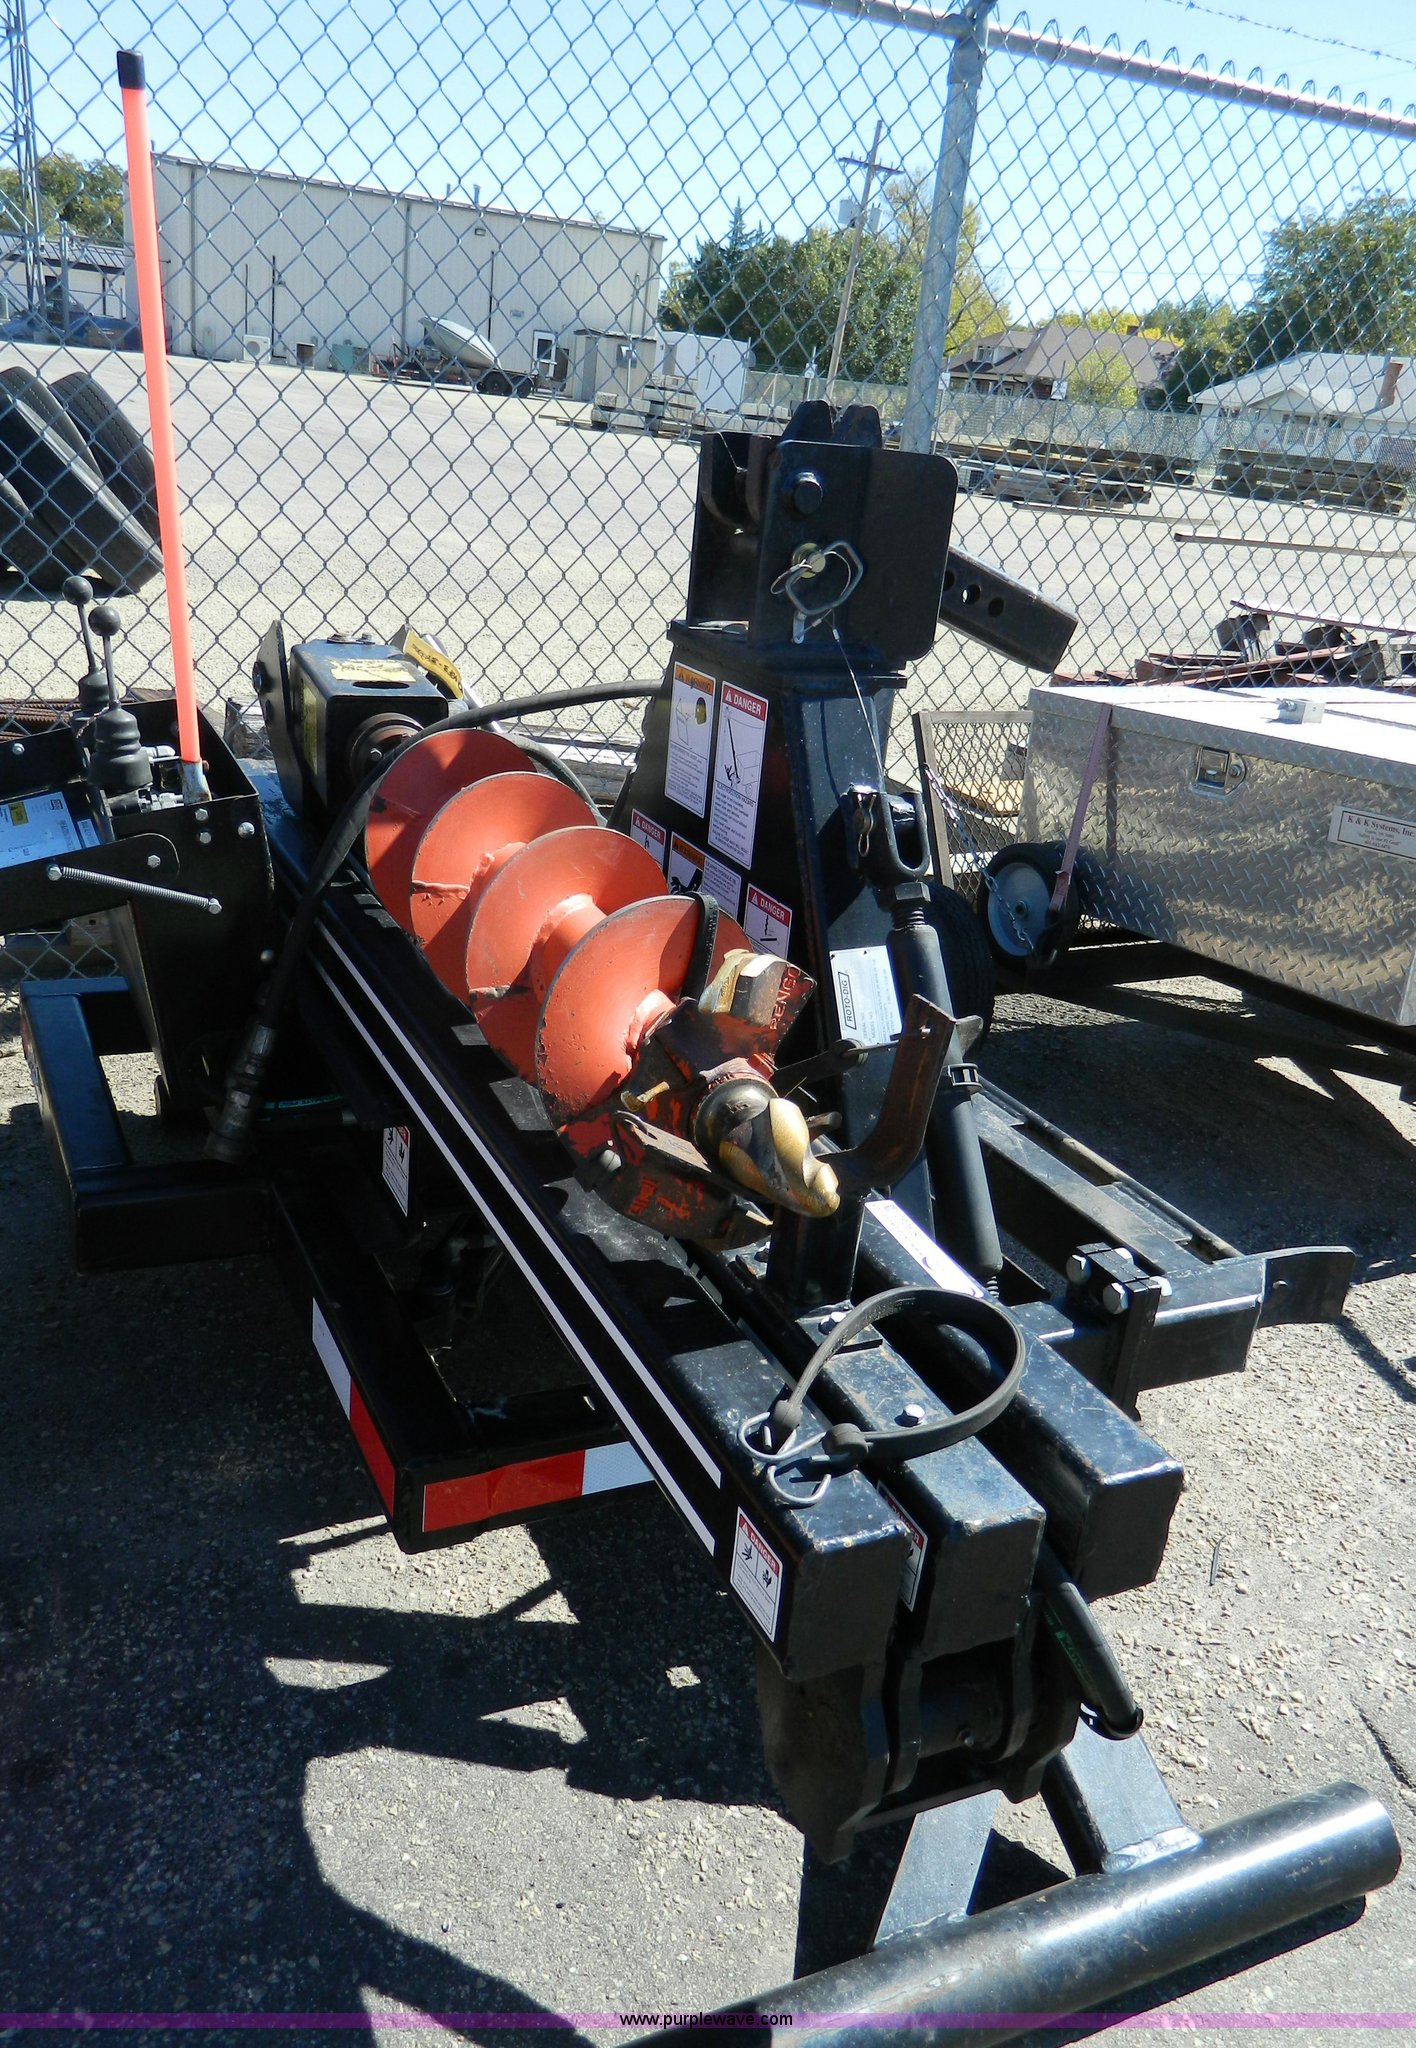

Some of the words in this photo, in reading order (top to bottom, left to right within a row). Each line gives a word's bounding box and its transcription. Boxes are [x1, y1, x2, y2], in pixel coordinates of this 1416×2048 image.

[733, 693, 762, 716] DANGER
[1402, 827, 1415, 837] Inc.
[760, 898, 785, 921] DANGER
[842, 980, 853, 1022] ROTO-DIG
[750, 1531, 776, 1571] DANGER
